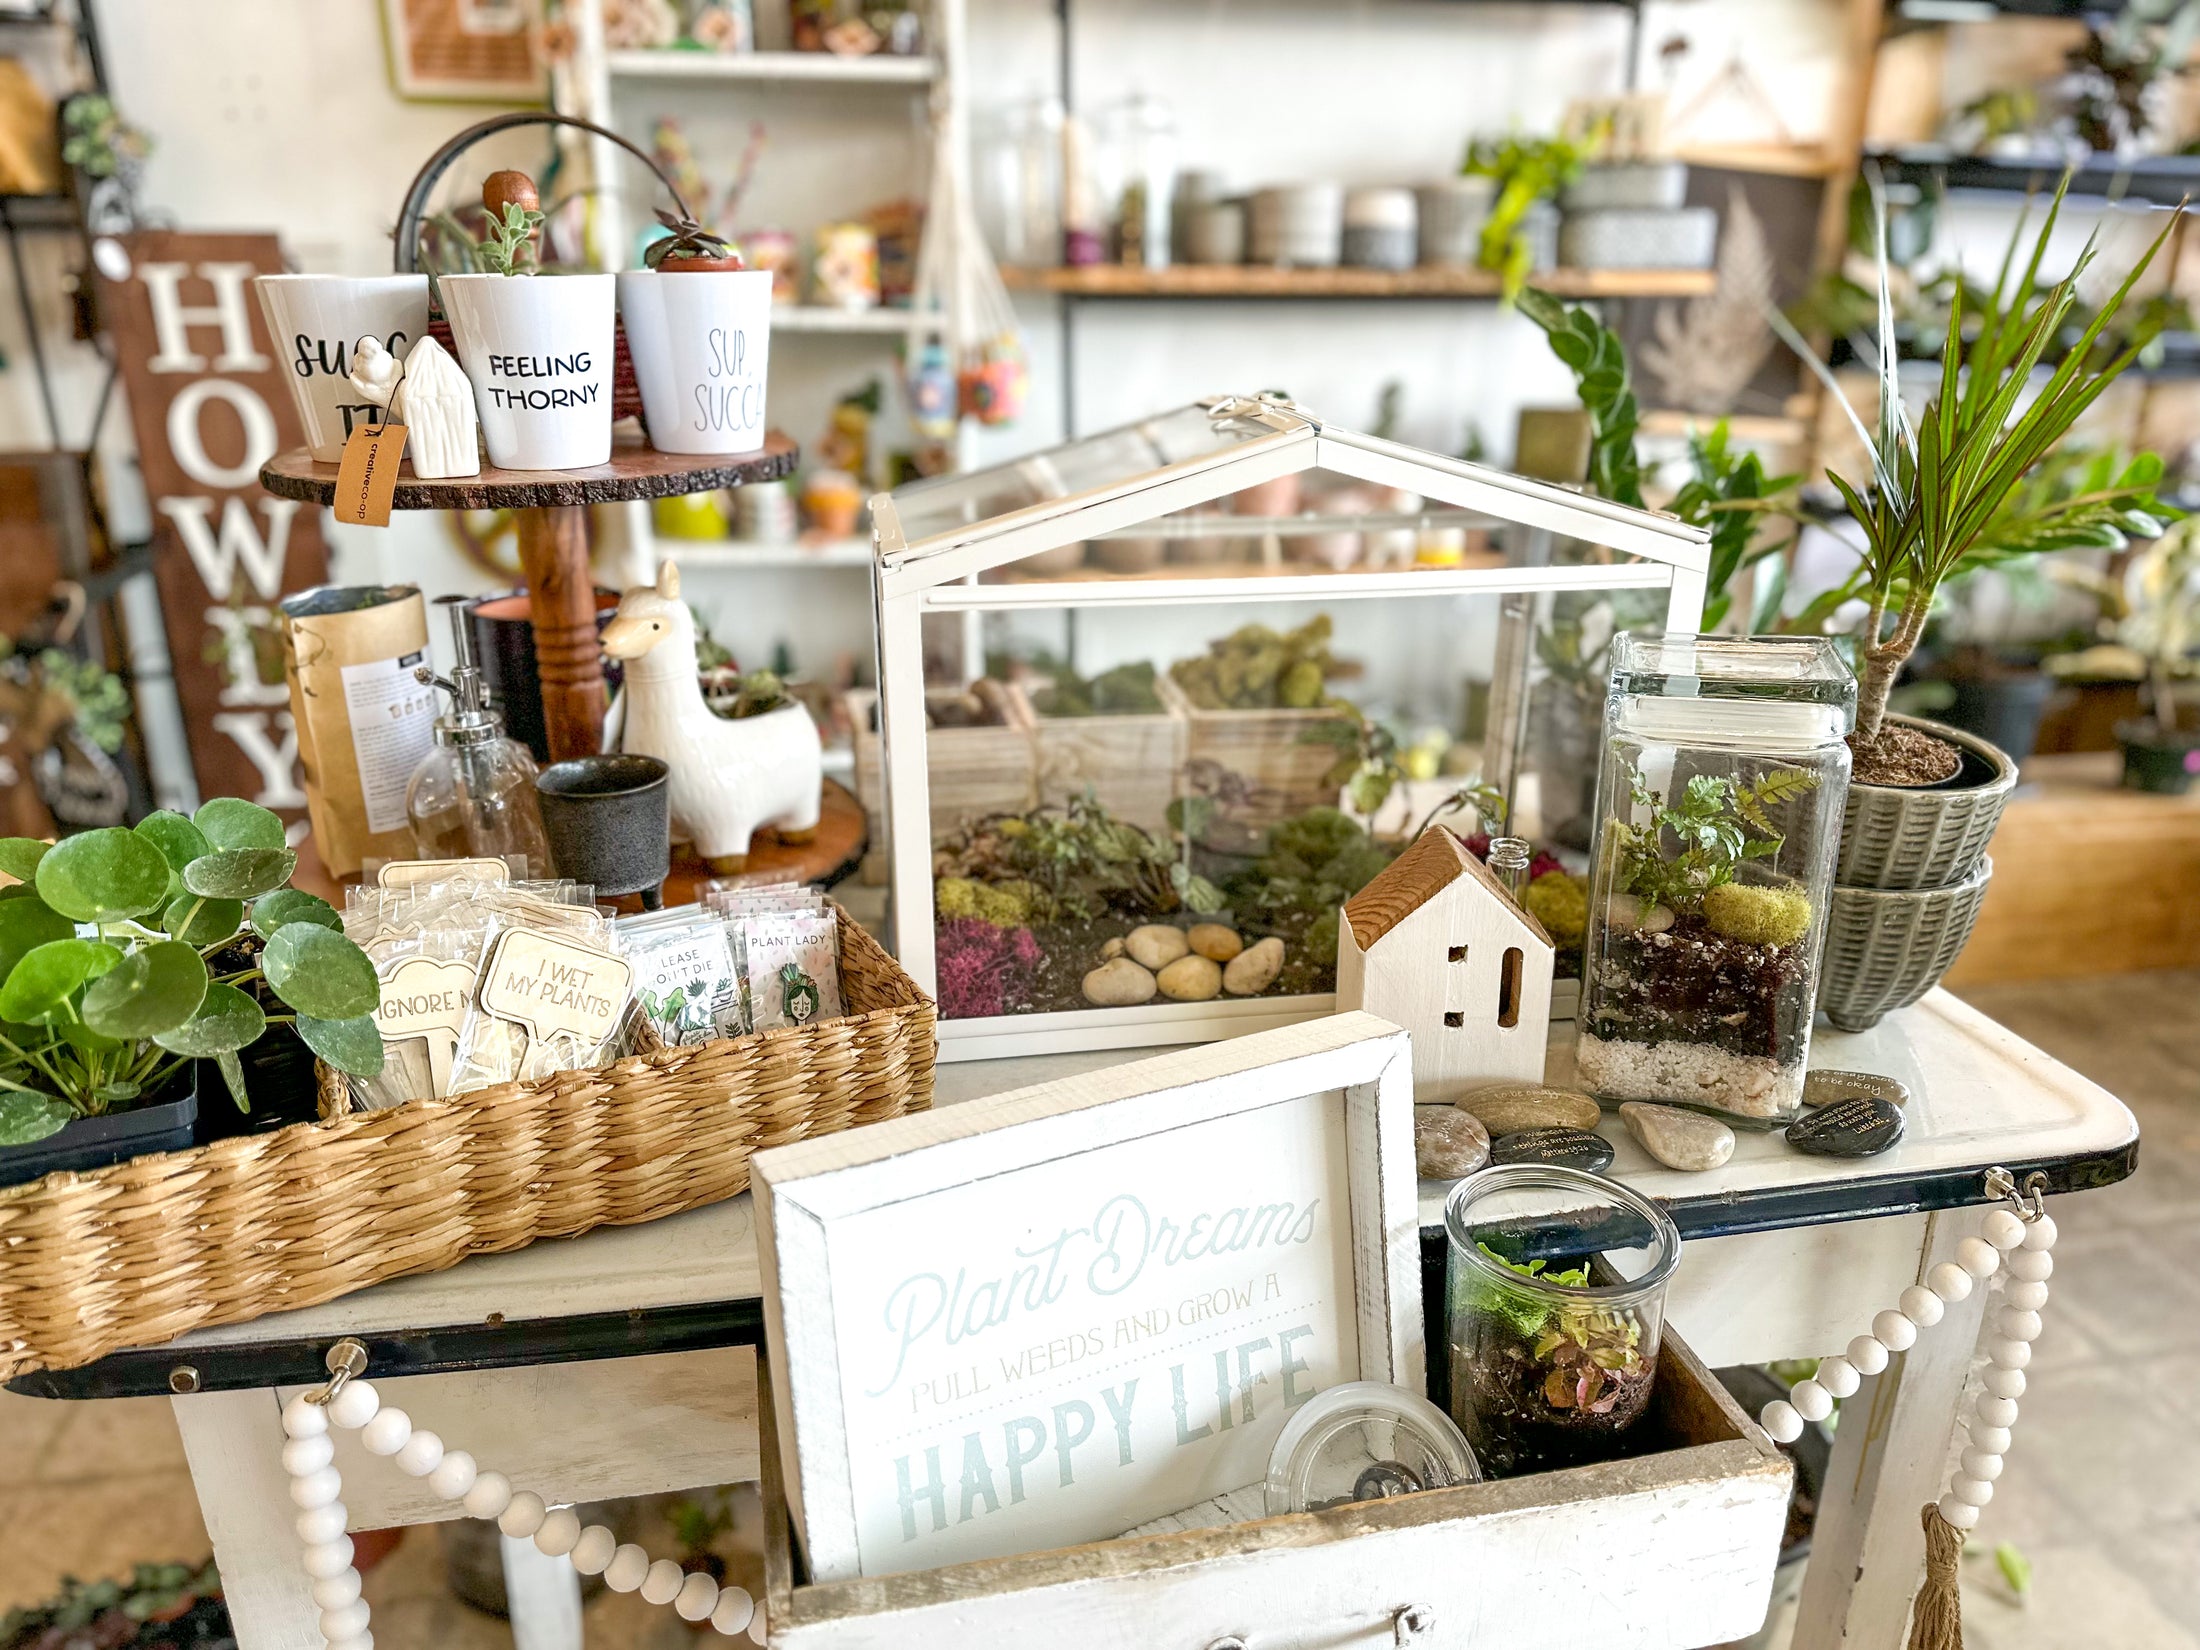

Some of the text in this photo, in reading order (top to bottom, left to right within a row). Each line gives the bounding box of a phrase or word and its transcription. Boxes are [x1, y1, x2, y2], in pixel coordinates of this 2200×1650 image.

[489, 351, 592, 377] FEELING
[488, 382, 599, 409] THORNY
[752, 935, 826, 947] PLANT LADY
[661, 949, 700, 968] LEASE
[693, 960, 714, 975] DIE
[538, 959, 593, 989] I WET
[378, 991, 455, 1020] IGNORE
[505, 972, 611, 1017] MY PLANTS
[865, 1194, 1321, 1398] Plant Dreams
[909, 1271, 1283, 1414] PULL WEEDS AND GROW A
[892, 1323, 1318, 1543] HAPPY LIFE
